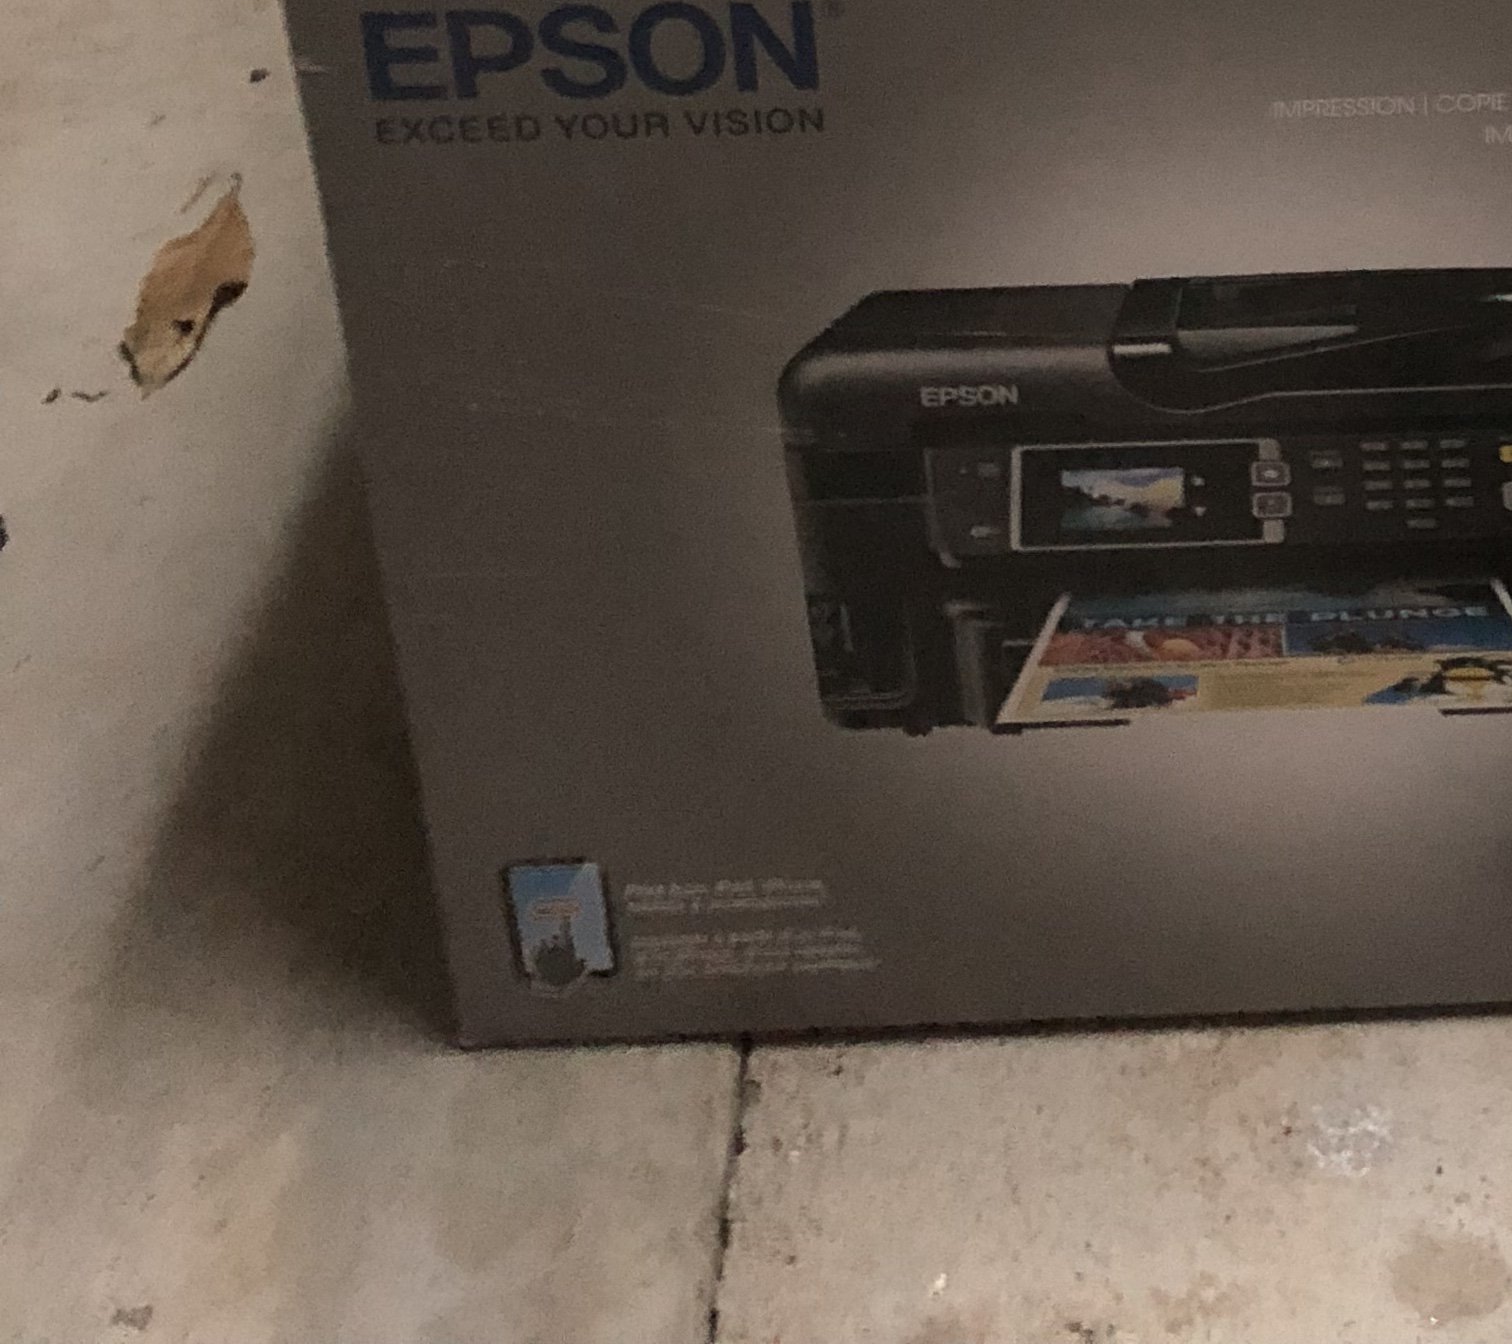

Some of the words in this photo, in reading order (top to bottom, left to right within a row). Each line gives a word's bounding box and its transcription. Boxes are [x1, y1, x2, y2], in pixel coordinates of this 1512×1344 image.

[361, 0, 820, 101] EPSON
[1271, 96, 1417, 119] IMPRESSION
[1435, 92, 1509, 114] COPIE
[376, 114, 541, 145] EXCEED
[554, 111, 670, 140] YOUR
[683, 106, 826, 136] VISION
[919, 384, 1019, 408] EPSON
